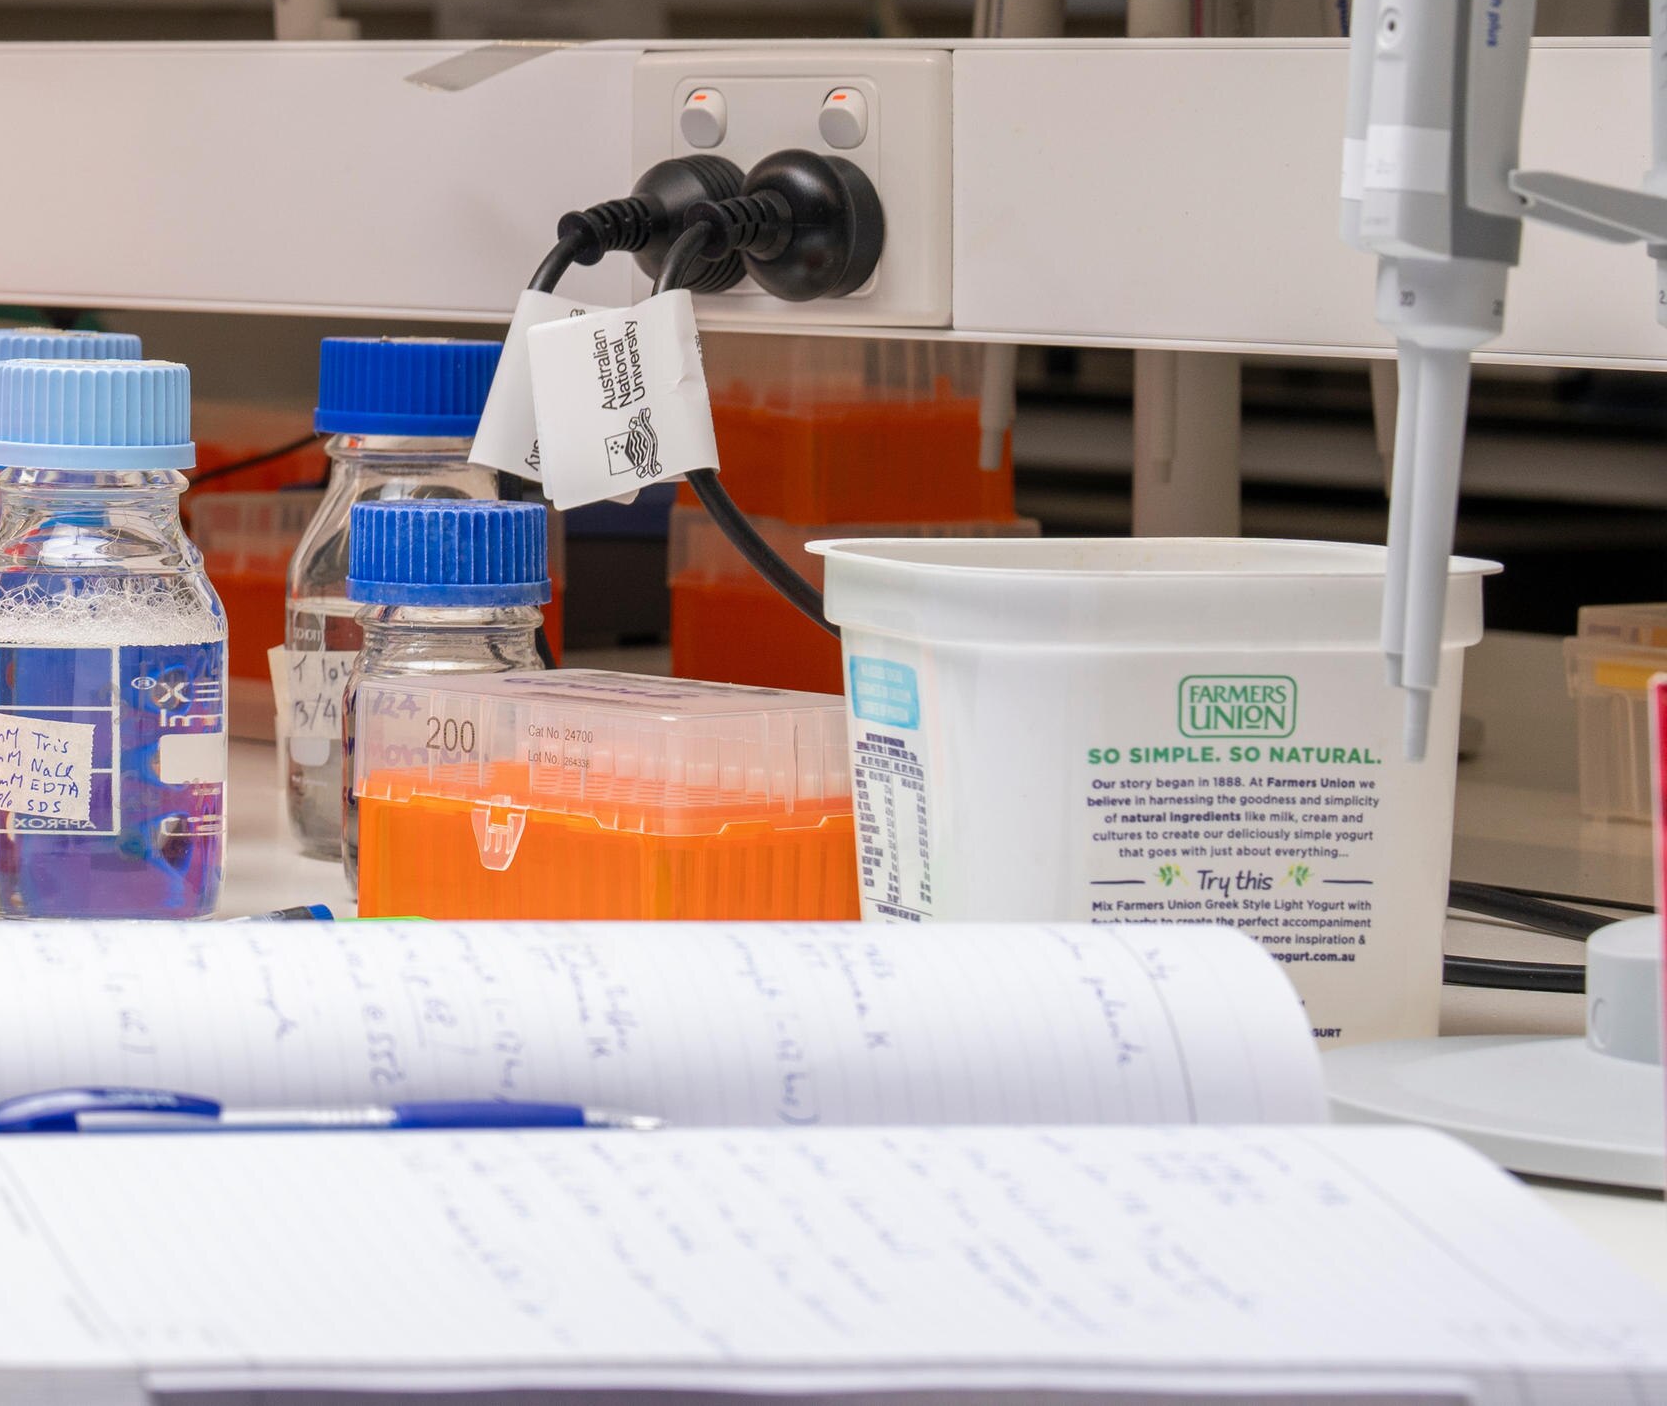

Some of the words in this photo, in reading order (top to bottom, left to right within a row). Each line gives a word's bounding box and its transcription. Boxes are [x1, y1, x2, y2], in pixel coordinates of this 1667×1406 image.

[625, 320, 646, 402] University
[594, 329, 618, 410] Australian
[610, 338, 632, 408] National
[1190, 686, 1286, 706] FARMERS
[1190, 705, 1285, 730] UNION
[426, 716, 475, 753] 200
[528, 724, 546, 739] Cat
[546, 726, 562, 742] No.
[565, 728, 593, 744] 24700
[32, 732, 69, 754] Tris
[528, 749, 544, 765] Lot
[545, 752, 560, 765] No.
[1089, 748, 1120, 764] SO
[1130, 747, 1220, 763] SIMPLE.
[1230, 747, 1260, 762] SO
[1270, 747, 1381, 764] NATURAL.
[31, 778, 79, 798] EDTA
[1092, 779, 1115, 789] Our
[1120, 779, 1152, 790] story
[1156, 778, 1194, 789] began
[1199, 778, 1209, 786] in
[1214, 777, 1244, 787] 1888.
[1250, 777, 1262, 786] At
[1267, 777, 1316, 787] Farmers
[1321, 778, 1355, 788] Union
[1359, 781, 1375, 789] we
[28, 799, 62, 813] SDS
[1087, 797, 1131, 806] believe
[1135, 796, 1145, 805] in
[1149, 795, 1214, 806] harnessing
[1217, 794, 1236, 804] the
[1240, 795, 1296, 806] goodness
[1300, 795, 1321, 805] and
[1325, 796, 1379, 808] simplicity
[1104, 813, 1117, 823] of
[1121, 812, 1166, 823] natural
[1170, 812, 1241, 823] ingredients
[1245, 812, 1265, 821] like
[1270, 812, 1298, 823] milk,
[1302, 814, 1338, 822] cream
[1342, 813, 1363, 823] and
[1093, 831, 1142, 841] cultures
[1146, 831, 1158, 839] to
[1162, 830, 1200, 839] create
[1203, 831, 1223, 839] our
[1227, 829, 1290, 841] deliciously
[1294, 830, 1332, 841] simple
[1335, 831, 1373, 842] yogurt
[1119, 848, 1143, 857] that
[1148, 849, 1177, 859] goes
[1181, 847, 1207, 856] with
[1210, 846, 1232, 857] just
[1236, 846, 1270, 856] about
[1275, 847, 1348, 859] everything...
[1197, 870, 1230, 900] Try
[1236, 870, 1273, 890] this
[1093, 902, 1112, 911] Mix
[1117, 901, 1164, 910] Farmers
[1168, 900, 1201, 910] Union
[1205, 897, 1239, 909] Greek
[1243, 899, 1271, 911] Style
[1275, 900, 1303, 911] Light
[1307, 900, 1344, 912] Yogurt
[1348, 901, 1371, 910] with
[1216, 916, 1235, 926] the
[1238, 916, 1279, 928] perfect
[1282, 918, 1371, 929] accompaniment
[1262, 936, 1291, 944] more
[1295, 934, 1355, 945] inspiration
[1358, 935, 1365, 944] &
[1311, 1029, 1341, 1037] GURT
